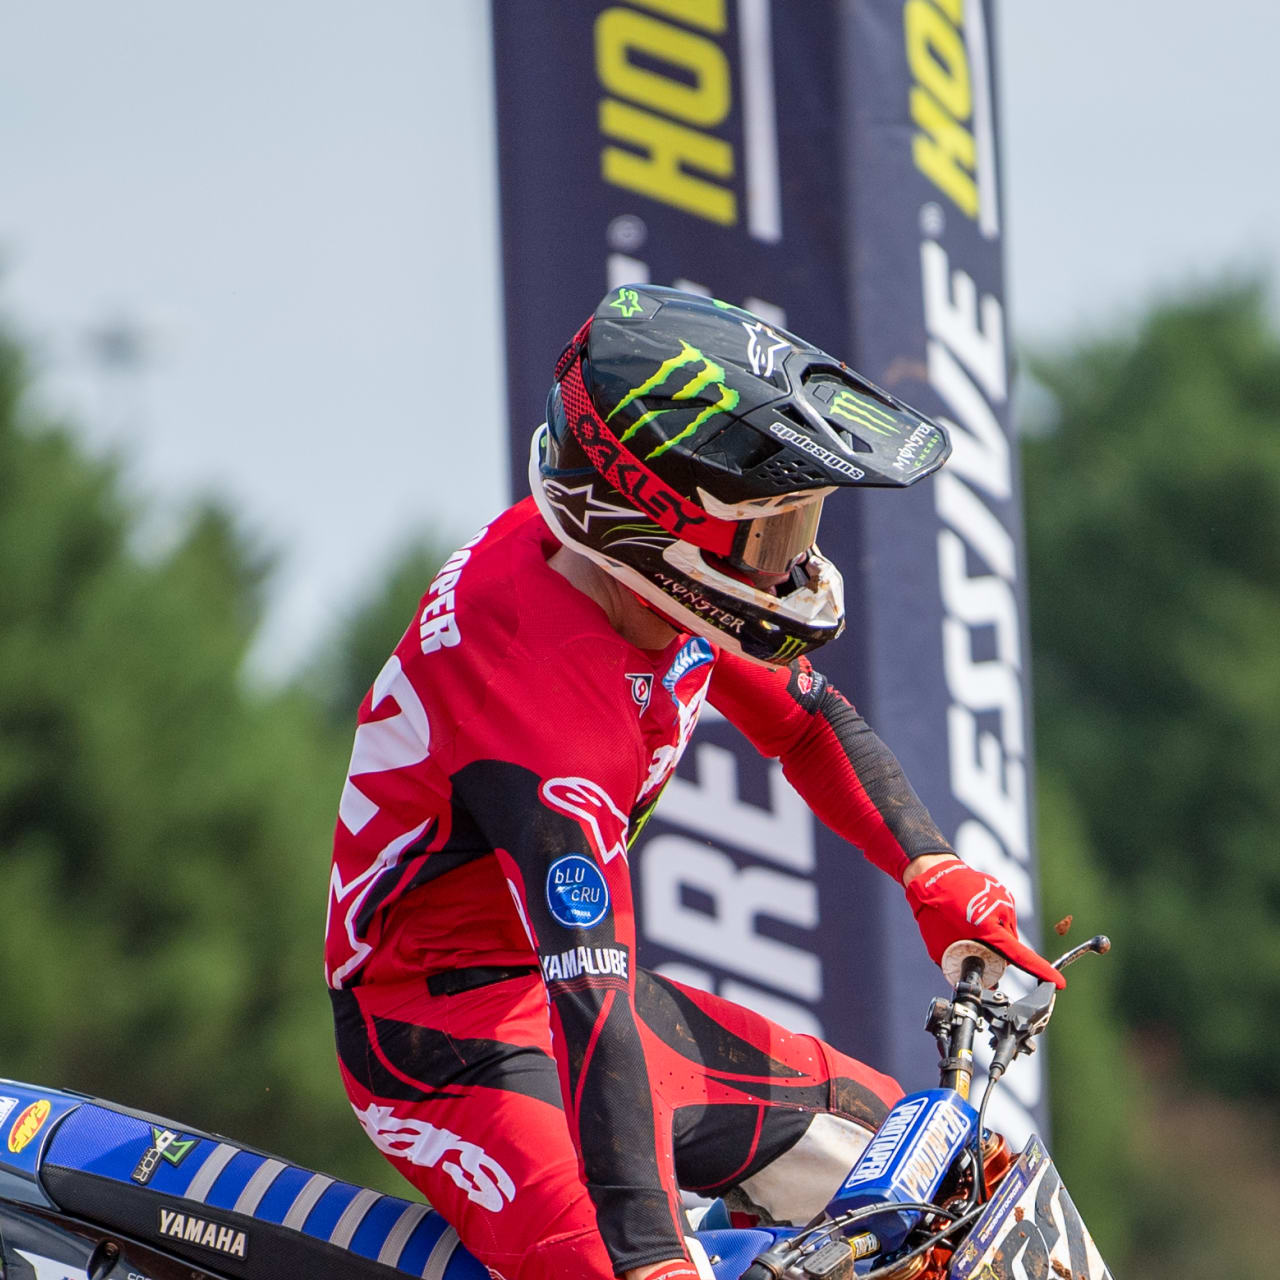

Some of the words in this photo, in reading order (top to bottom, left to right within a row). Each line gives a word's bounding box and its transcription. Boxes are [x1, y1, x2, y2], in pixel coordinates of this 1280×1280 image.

[770, 421, 865, 480] apdesigns
[893, 421, 935, 470] MONSTER
[576, 413, 707, 532] OAKLEY
[539, 946, 628, 981] YAMALUBE
[159, 1208, 248, 1258] YAMAHA
